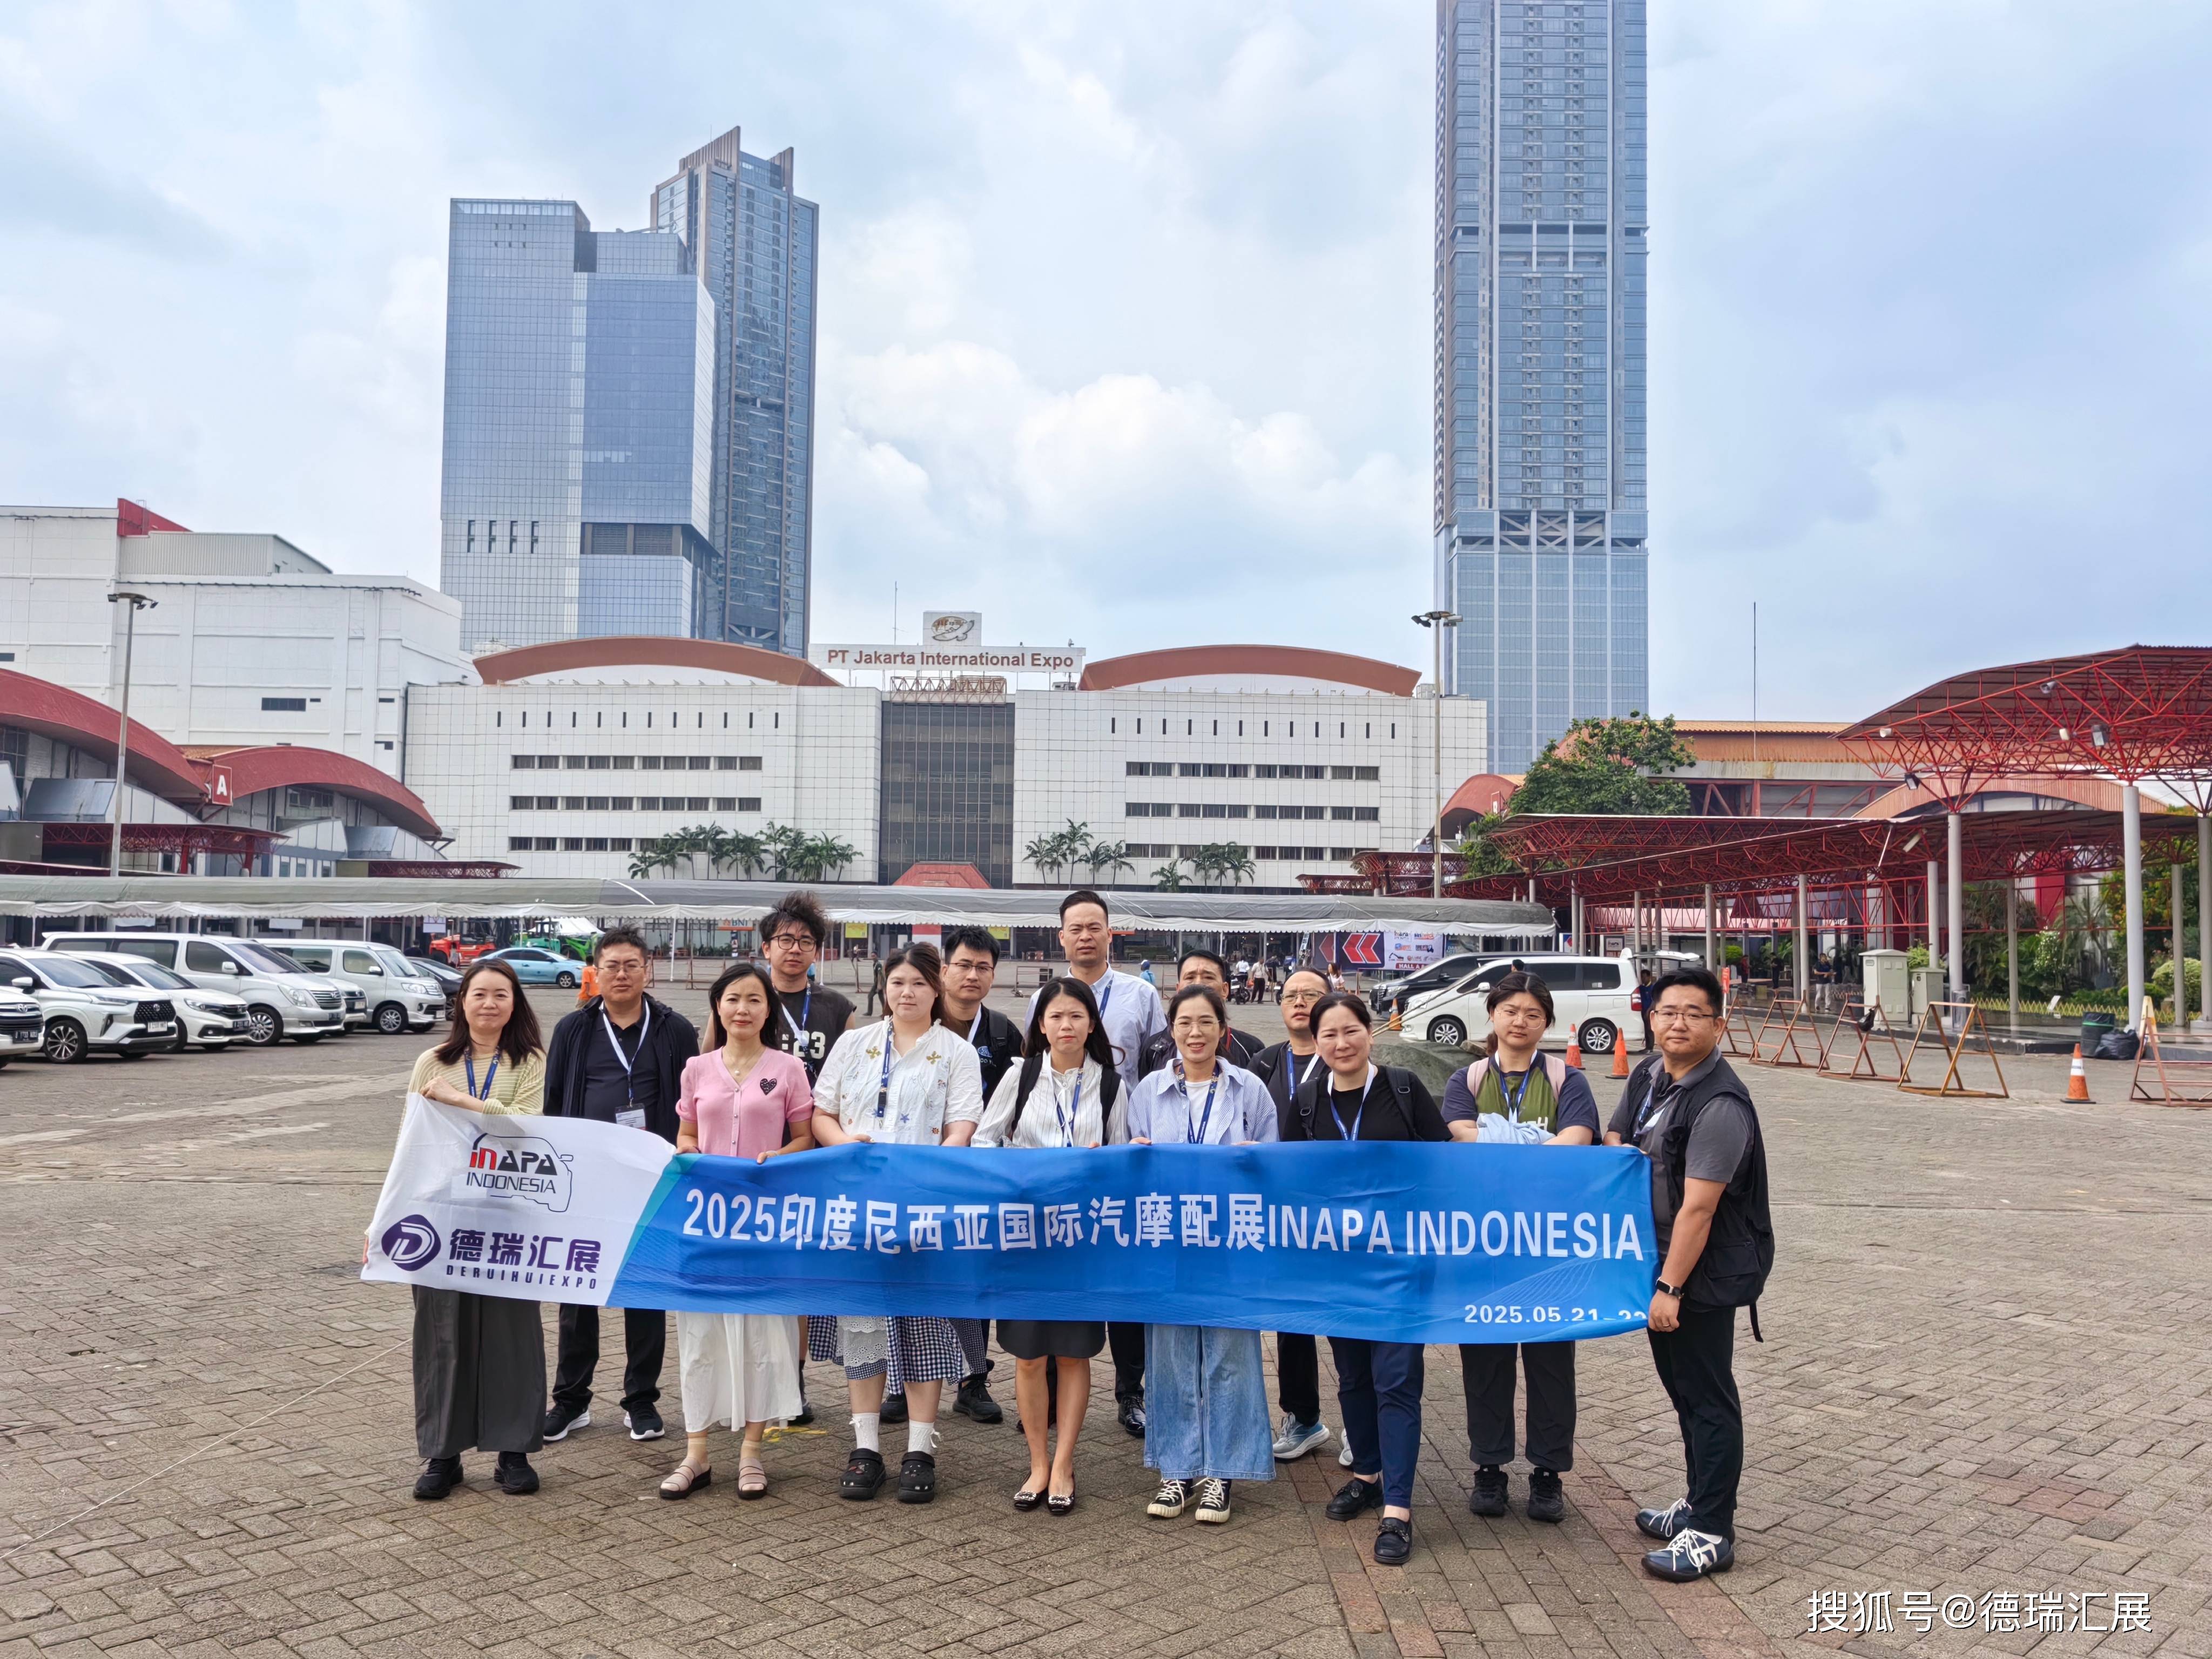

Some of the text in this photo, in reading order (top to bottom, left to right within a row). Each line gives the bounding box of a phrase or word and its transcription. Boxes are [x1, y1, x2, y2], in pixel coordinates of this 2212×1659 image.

[827, 650, 1074, 667] PT Jakarta International Expo
[217, 774, 227, 796] A
[466, 1171, 556, 1194] INDONESIA
[1406, 1210, 1644, 1262] INDONESIA
[448, 1229, 601, 1273] 德瑞汇展
[446, 1265, 597, 1290] DERUIHUIEXPO
